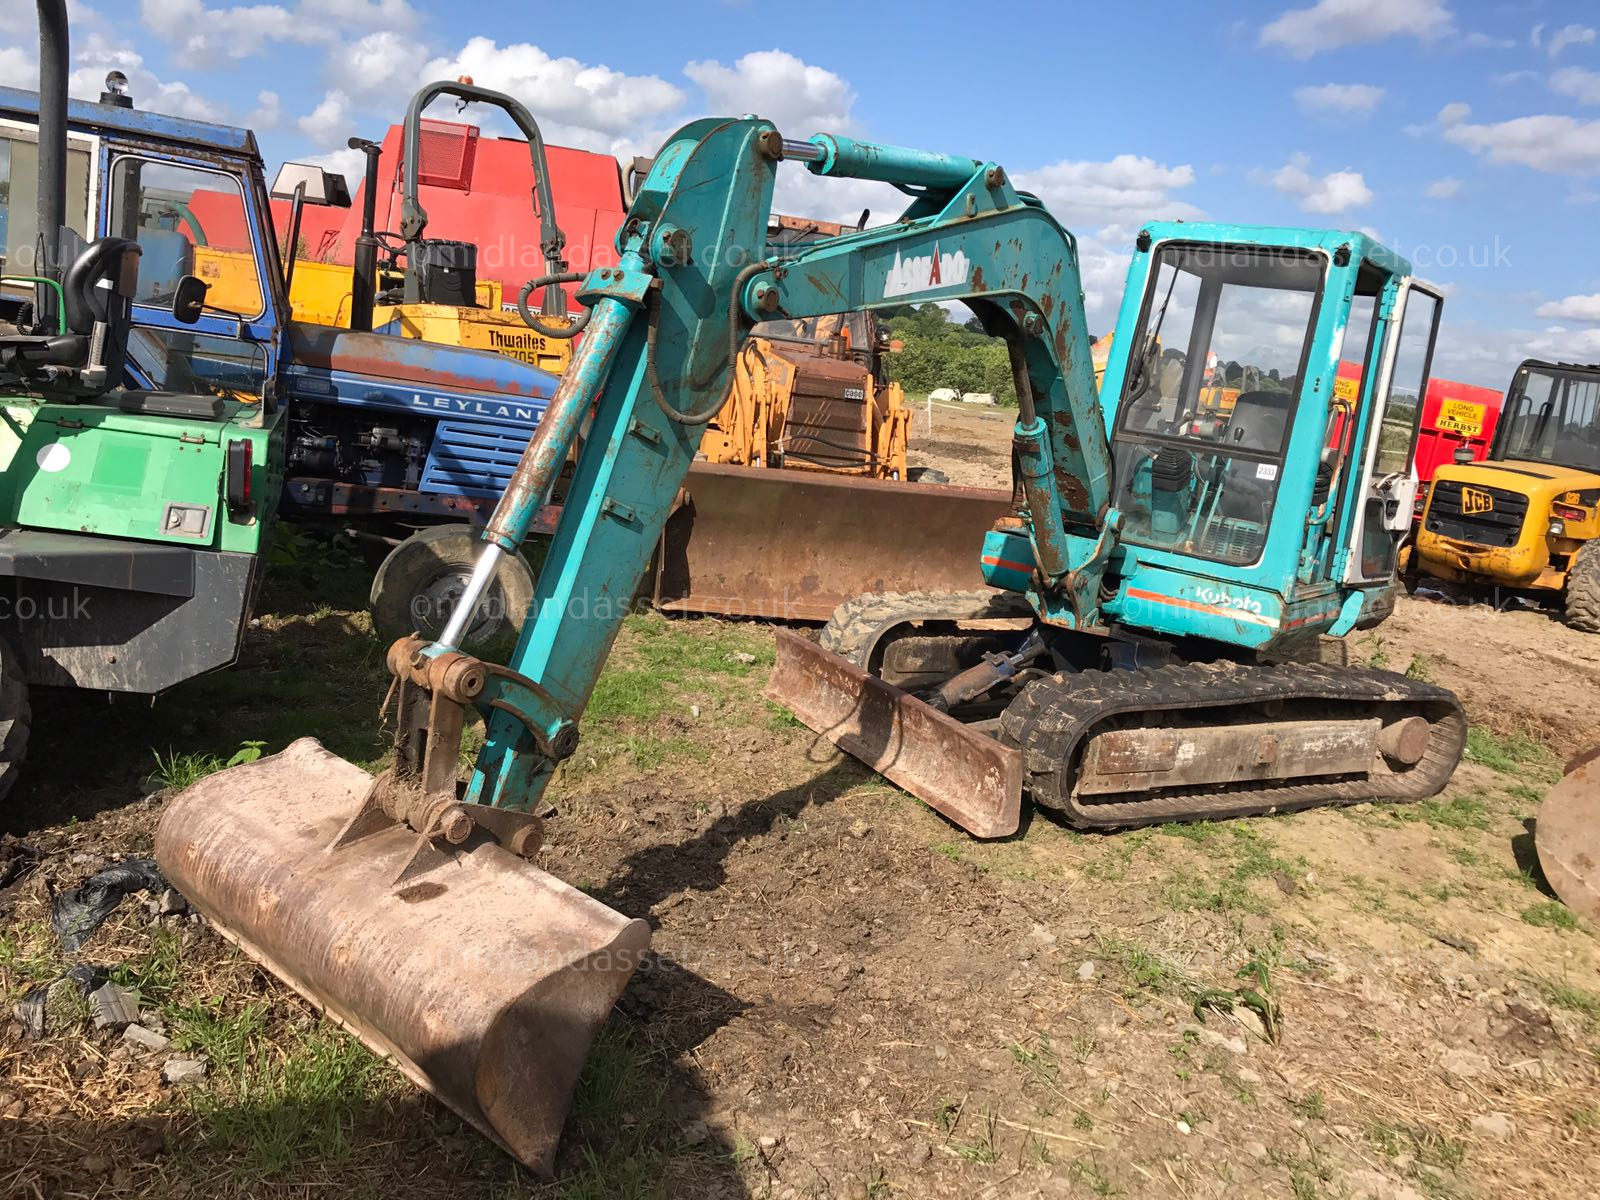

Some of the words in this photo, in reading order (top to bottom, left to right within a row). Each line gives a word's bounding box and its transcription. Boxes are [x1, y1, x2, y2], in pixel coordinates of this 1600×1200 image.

[488, 330, 546, 351] Thwaites
[1447, 408, 1478, 419] VEHICLE
[1453, 403, 1474, 413] LONG
[1440, 419, 1479, 432] HERBST
[1258, 467, 1275, 476] 2333
[1465, 489, 1491, 512] JCB
[1195, 586, 1262, 613] Kubota
